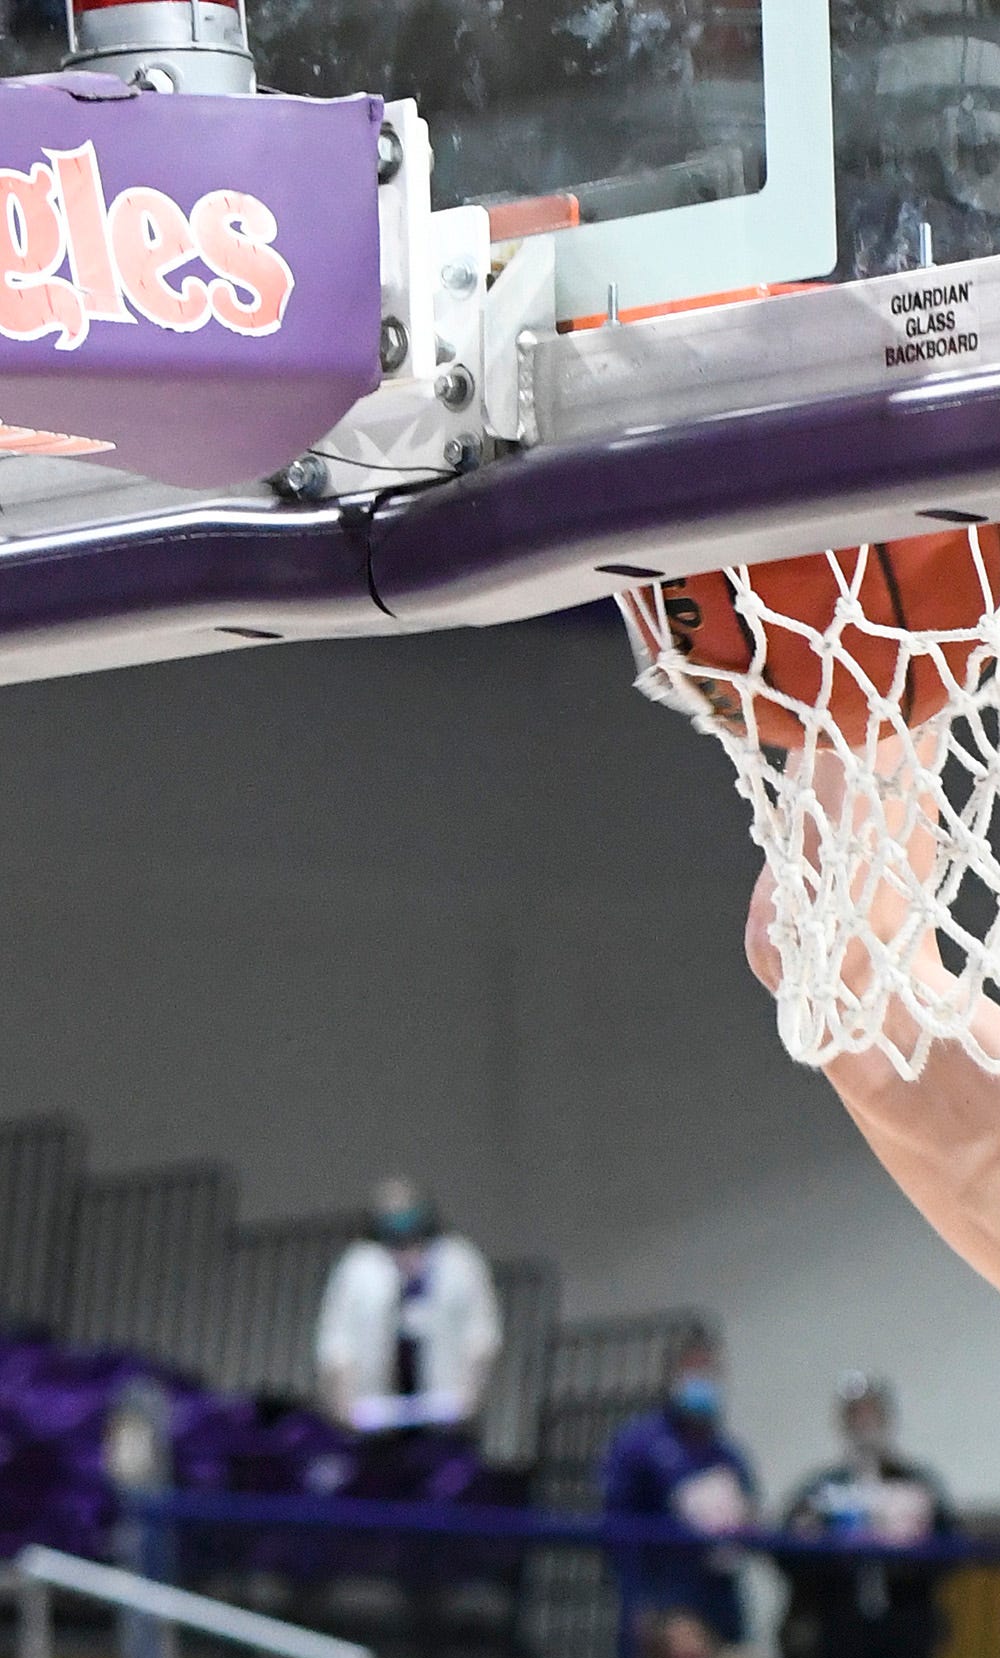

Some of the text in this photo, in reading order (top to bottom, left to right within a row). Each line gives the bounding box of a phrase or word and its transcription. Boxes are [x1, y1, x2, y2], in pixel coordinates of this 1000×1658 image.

[891, 281, 970, 315] GUARDIAN
[905, 310, 956, 338] GLASS
[885, 332, 979, 367] BACKBOARD
